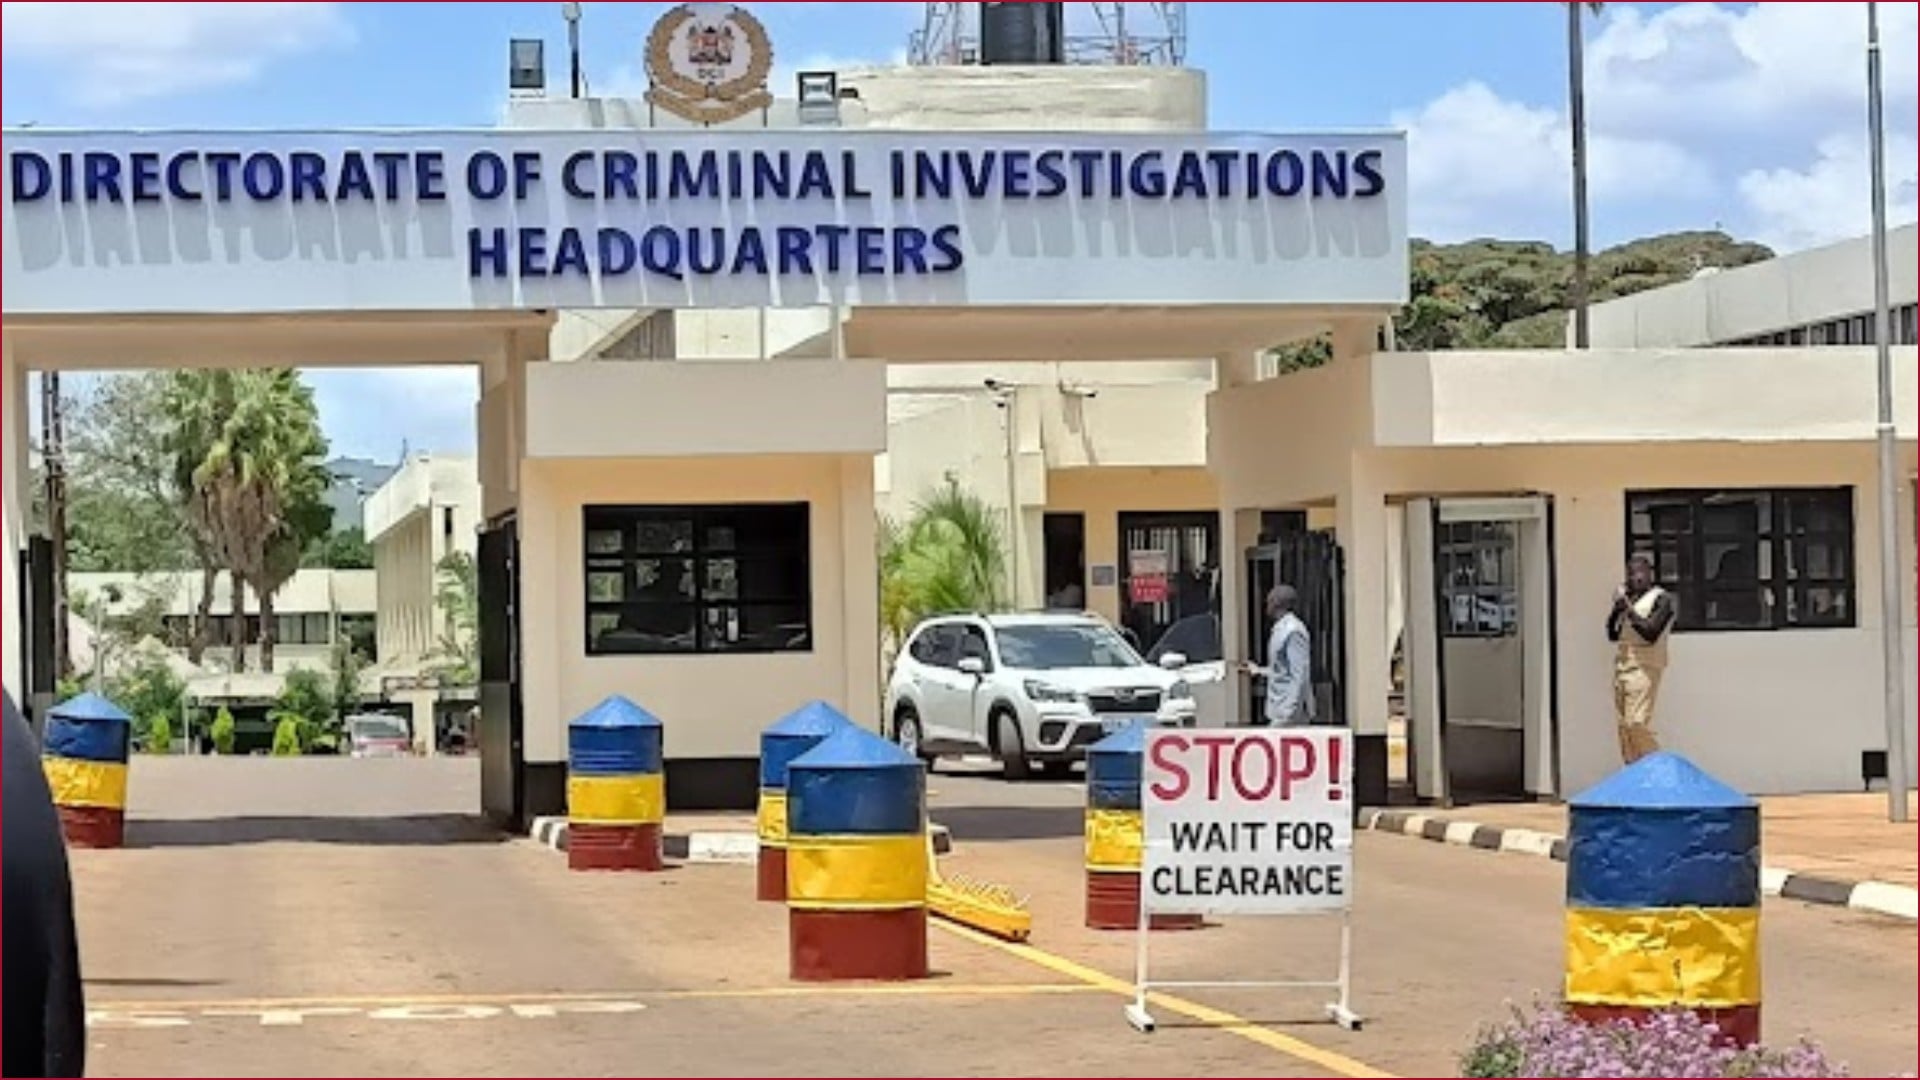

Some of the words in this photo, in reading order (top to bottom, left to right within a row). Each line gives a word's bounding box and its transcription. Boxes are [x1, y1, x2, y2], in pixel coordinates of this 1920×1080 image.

[11, 151, 447, 203] DIRECTORATE
[466, 150, 541, 200] OF
[561, 150, 871, 202] CRIMINAL
[890, 149, 1385, 199] INVESTIGATIONS
[468, 224, 964, 280] HEADQUARTERS
[1150, 735, 1343, 801] STOP!
[1170, 822, 1267, 852] WAIT
[1276, 822, 1334, 851] FOR
[1152, 865, 1344, 896] CLEARANCE
